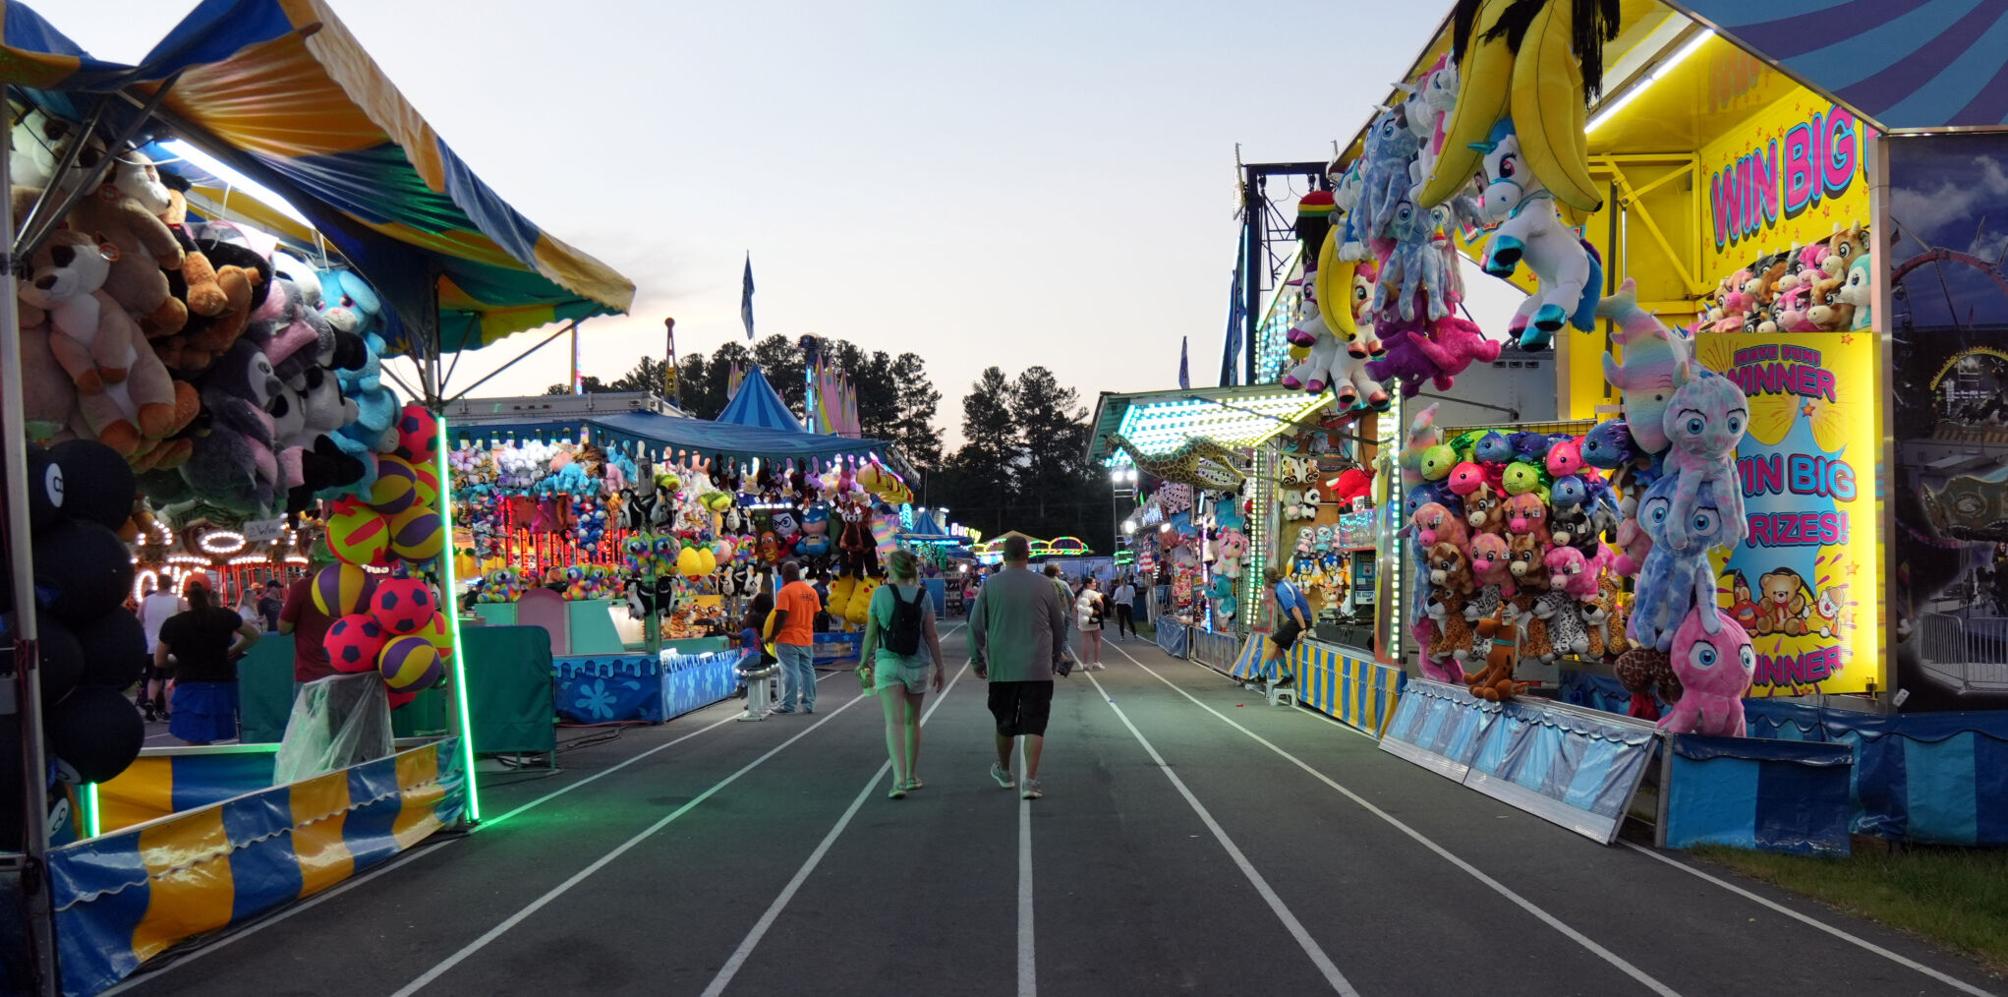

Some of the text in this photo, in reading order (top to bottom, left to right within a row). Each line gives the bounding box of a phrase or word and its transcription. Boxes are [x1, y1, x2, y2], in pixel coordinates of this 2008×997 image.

[1711, 137, 1779, 253] WIN
[1783, 103, 1858, 220] BIG
[1726, 362, 1837, 404] WINNER
[1787, 452, 1858, 504] BIG
[1744, 510, 1851, 549] RIZES!
[1753, 644, 1843, 687] INNER
